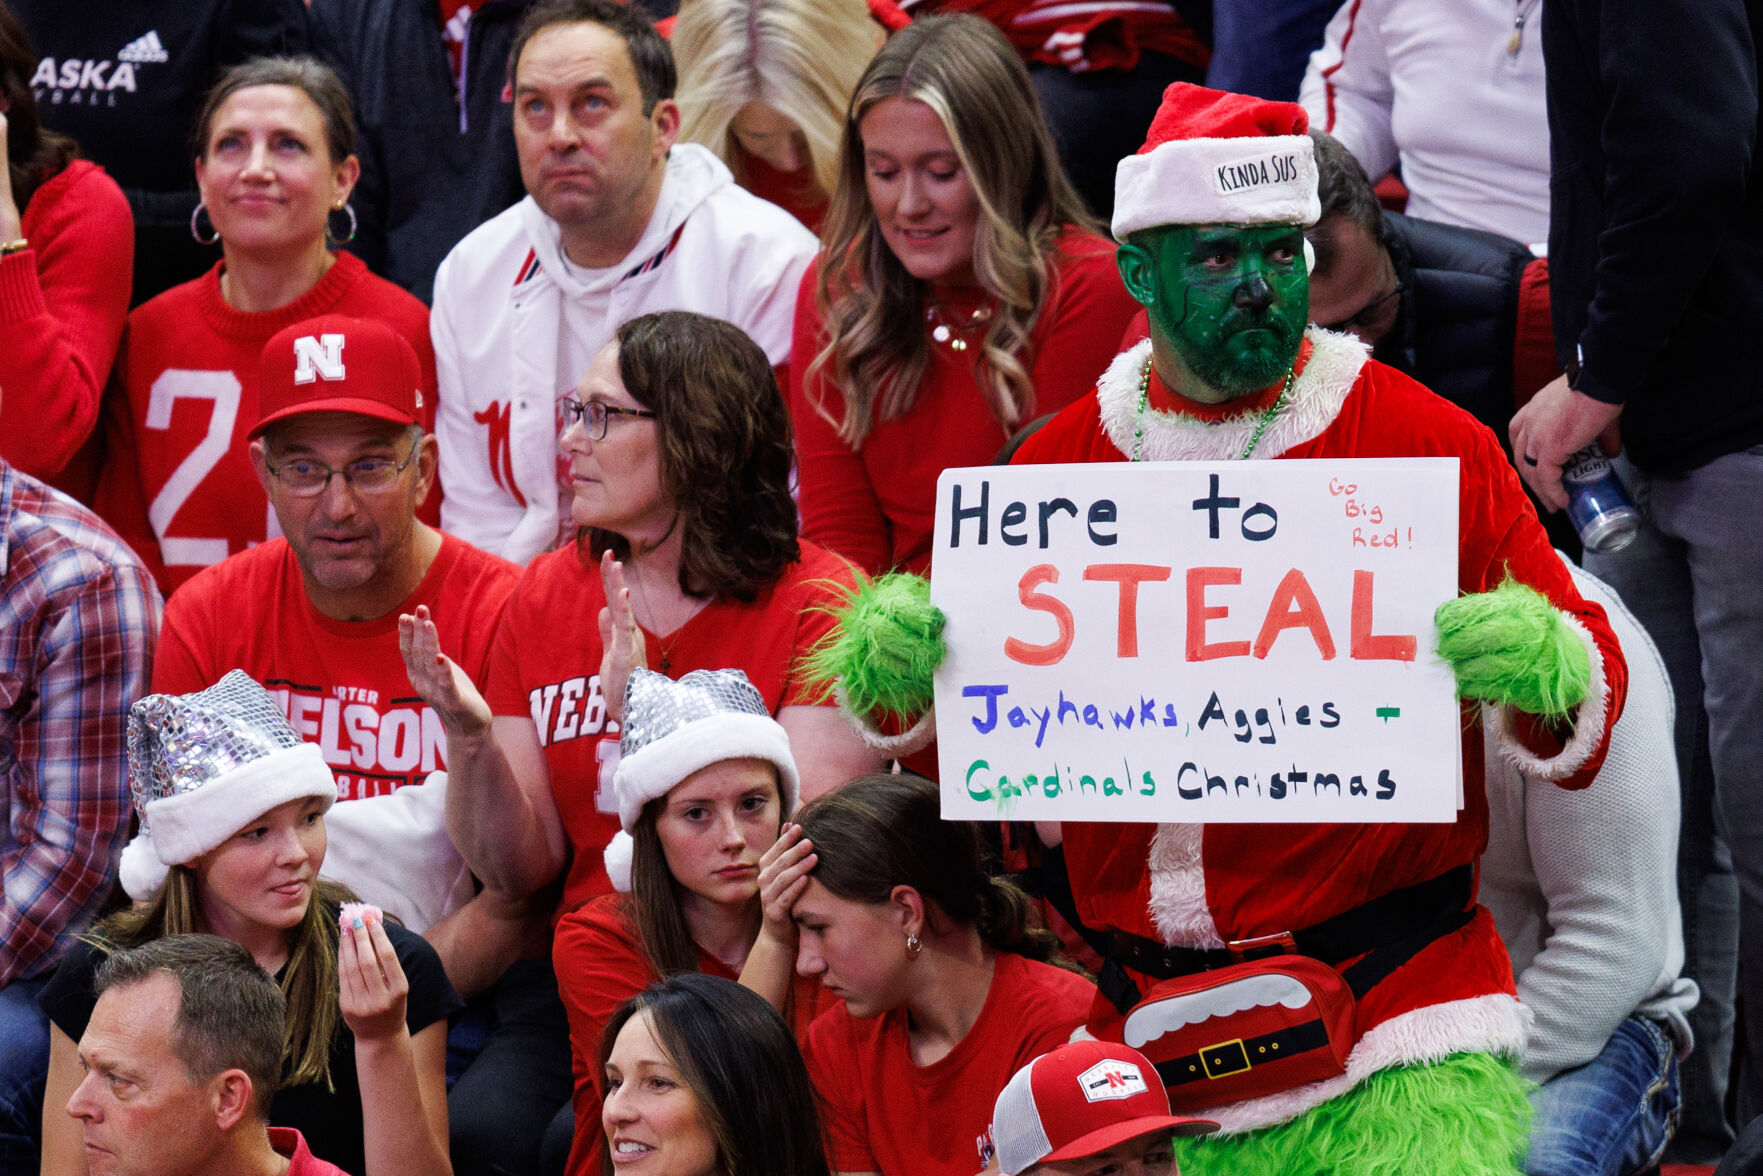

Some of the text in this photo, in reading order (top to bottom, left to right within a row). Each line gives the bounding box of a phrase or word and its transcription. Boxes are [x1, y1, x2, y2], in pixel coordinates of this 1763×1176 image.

[1217, 155, 1297, 191] KINDA SUS
[293, 334, 346, 385] N
[1328, 476, 1358, 496] Go
[950, 474, 1278, 548] Here to
[1344, 498, 1383, 524] Big
[1003, 563, 1418, 668] STEAL
[1198, 690, 1341, 744] Aggies
[965, 757, 1397, 802] Cardinals Christmas
[1105, 1071, 1127, 1090] N
